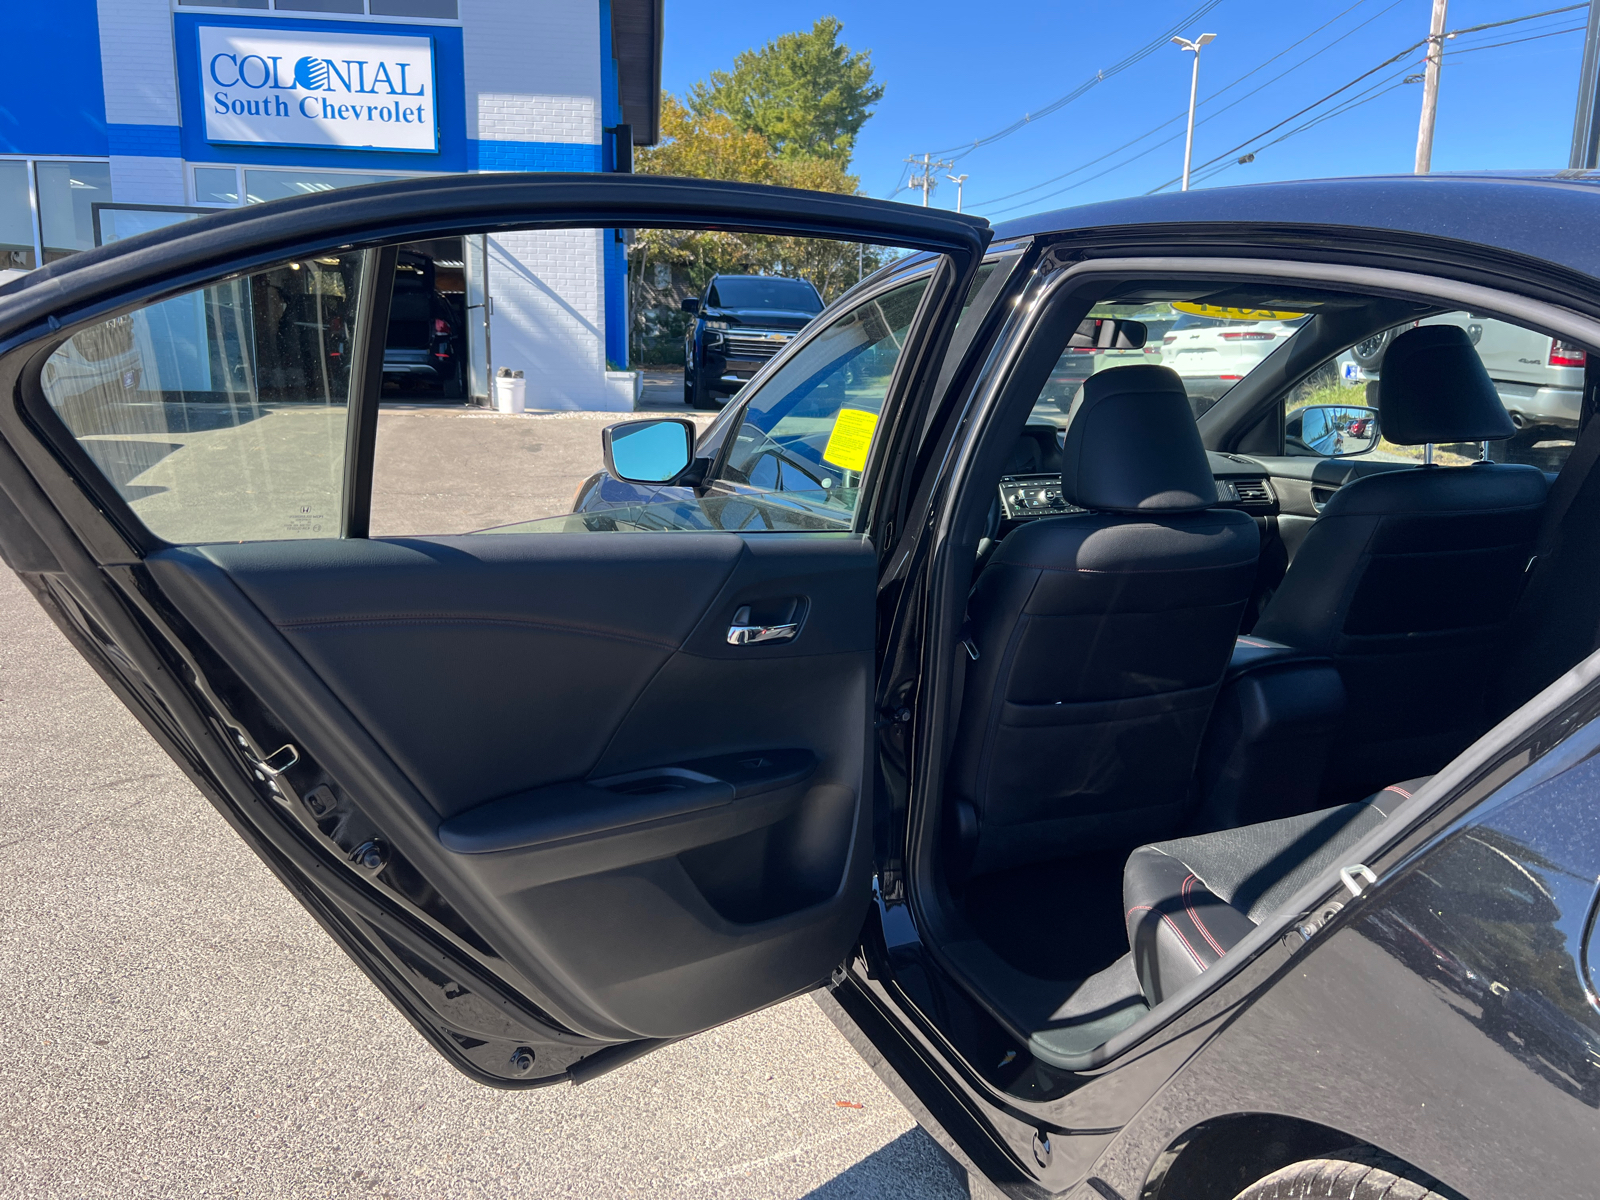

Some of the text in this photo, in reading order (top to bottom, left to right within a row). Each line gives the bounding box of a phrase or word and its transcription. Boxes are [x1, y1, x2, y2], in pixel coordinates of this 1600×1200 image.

[210, 53, 424, 96] COLONIAL
[214, 91, 426, 124] South Chevrolet
